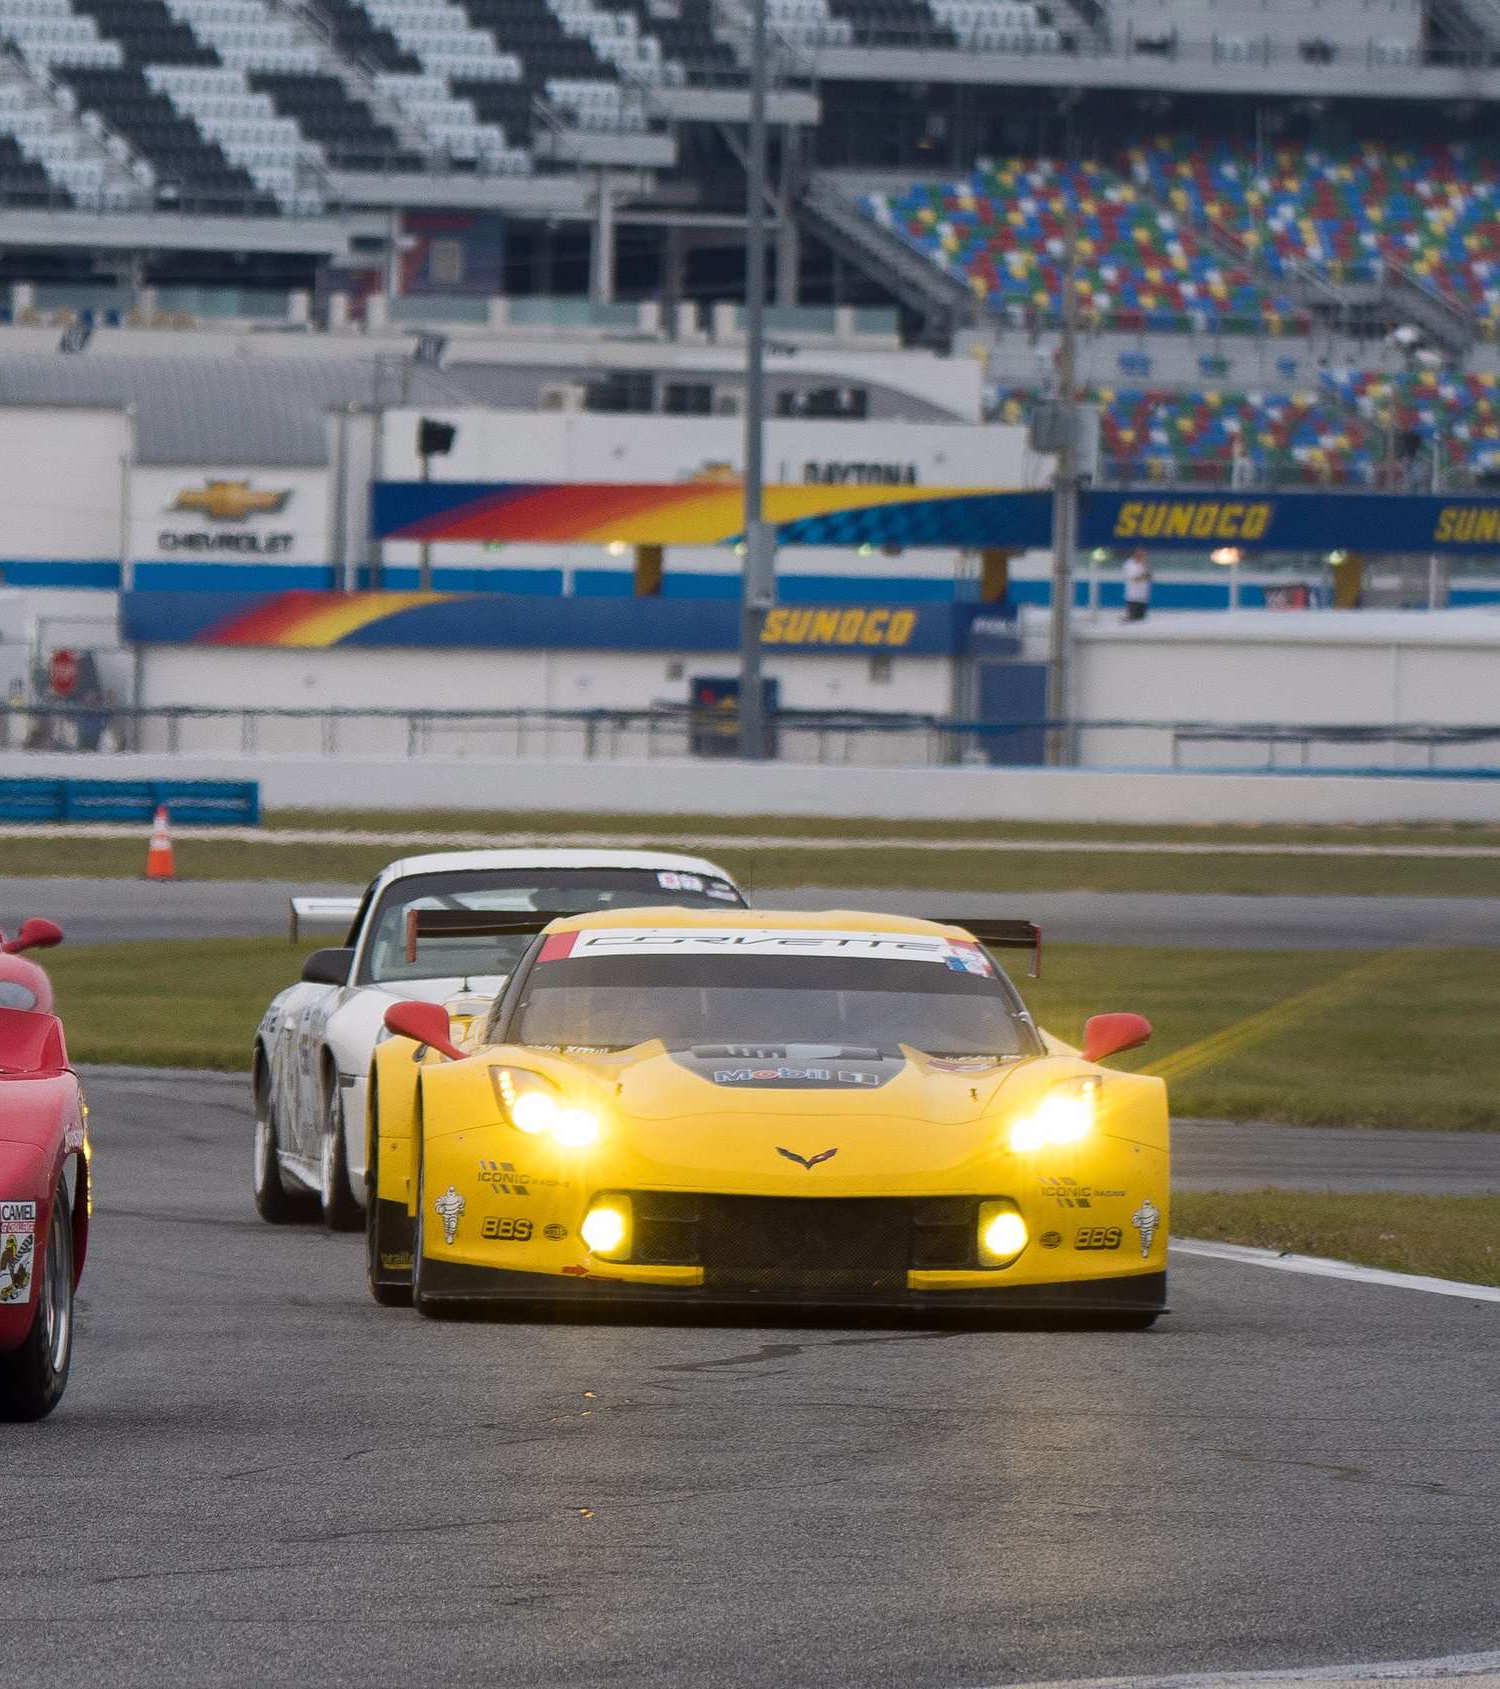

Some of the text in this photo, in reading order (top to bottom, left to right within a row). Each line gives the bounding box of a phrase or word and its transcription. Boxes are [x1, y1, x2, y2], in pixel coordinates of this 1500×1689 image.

[1113, 503, 1272, 539] SUNOCO
[158, 532, 293, 553] CHEVROLET
[760, 608, 917, 646] SUNOCO
[585, 936, 942, 952] CORVETTE
[713, 1068, 830, 1083] Mobil
[478, 1171, 531, 1185] ICONIC
[1041, 1186, 1092, 1197] ICONIC
[1, 1205, 35, 1220] CAMEL
[481, 1216, 533, 1241] BBS
[1074, 1227, 1122, 1250] BBS
